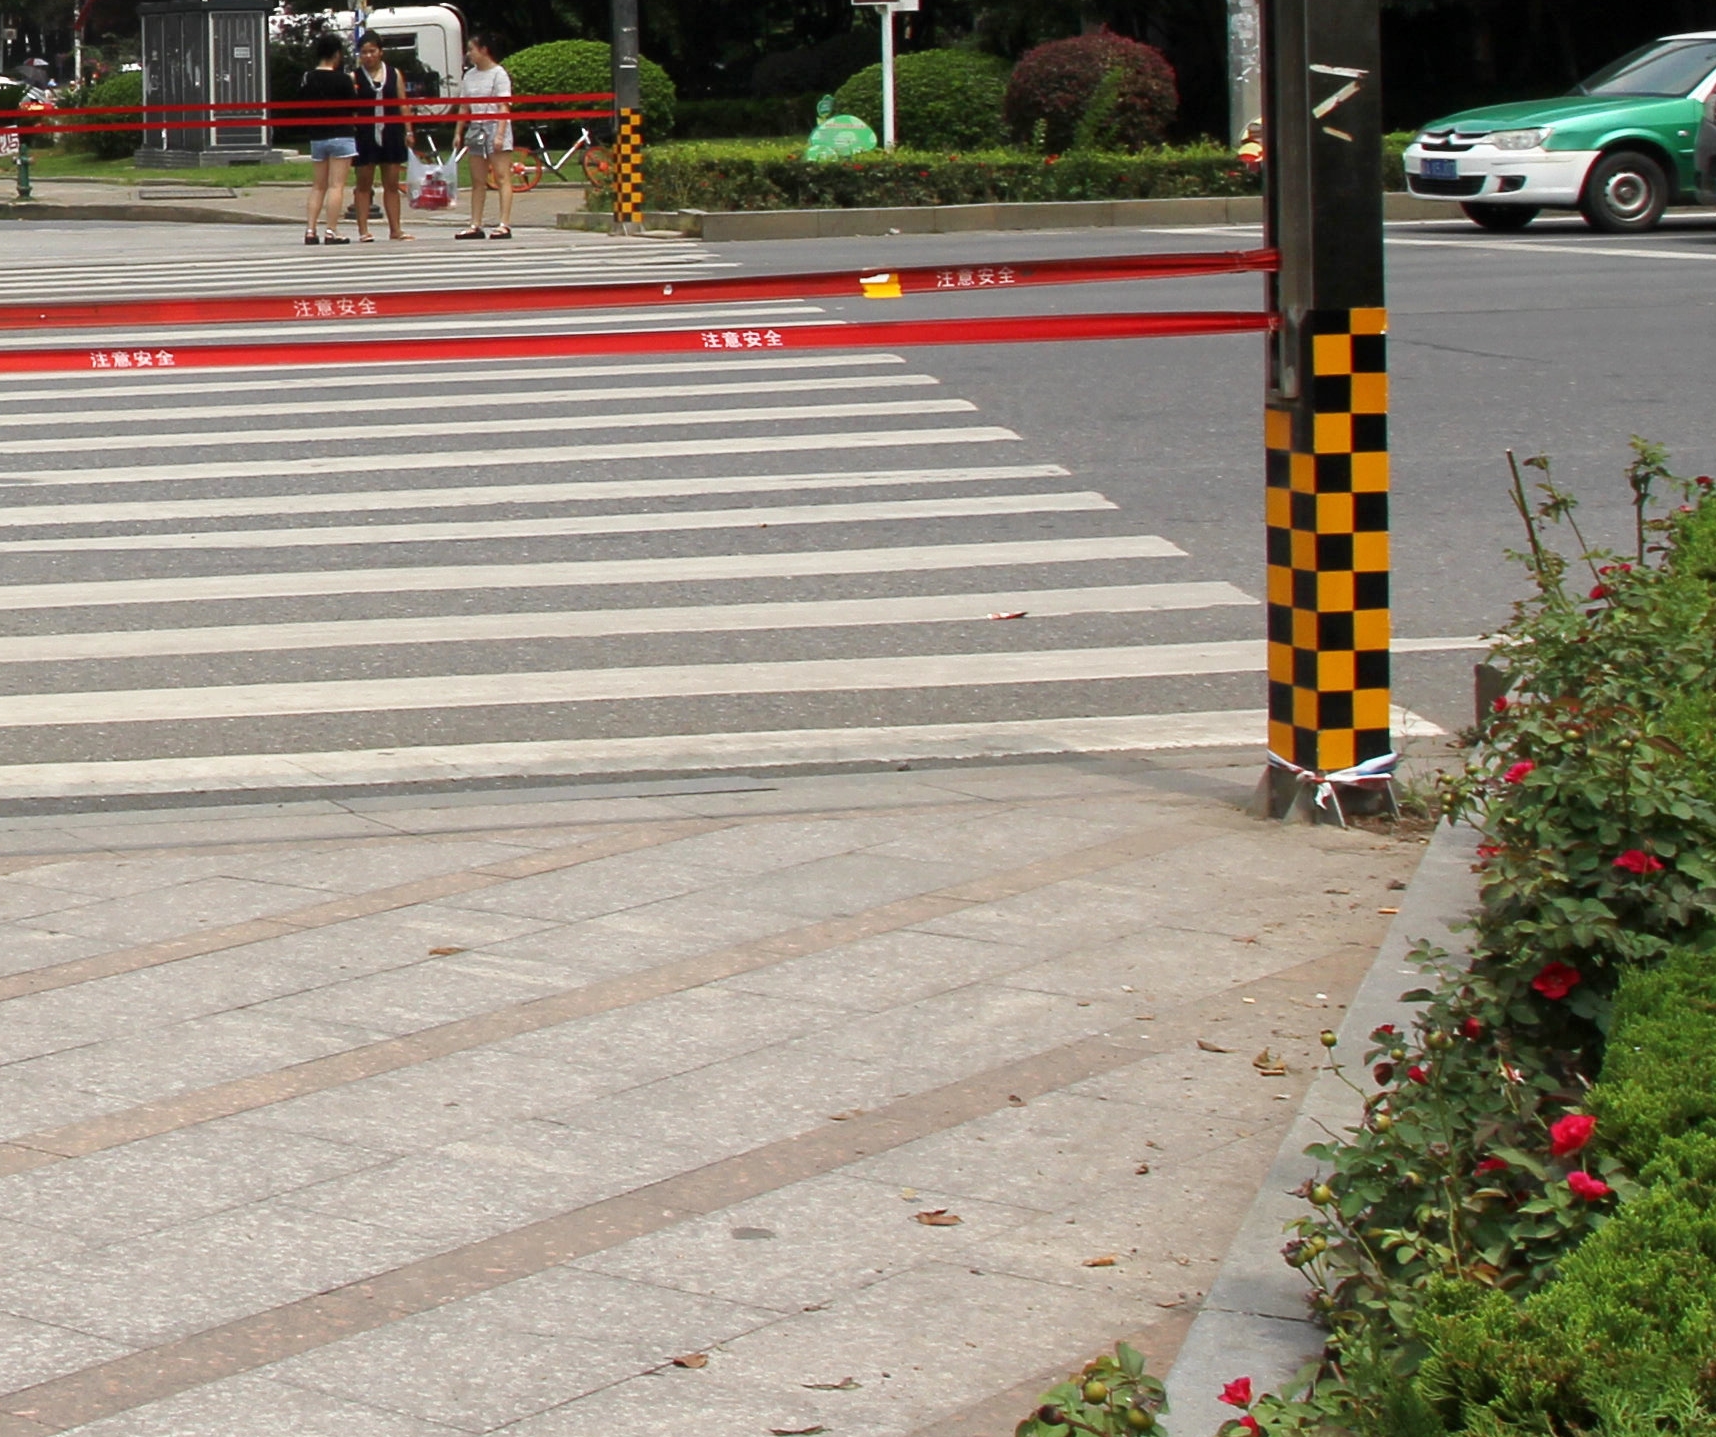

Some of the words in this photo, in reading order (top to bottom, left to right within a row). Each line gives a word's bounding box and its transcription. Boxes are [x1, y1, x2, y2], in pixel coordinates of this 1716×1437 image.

[936, 267, 1016, 288] 注意安全
[293, 297, 378, 318] 注意安全
[701, 330, 784, 348] 注意安全
[89, 350, 175, 369] 注意安全
